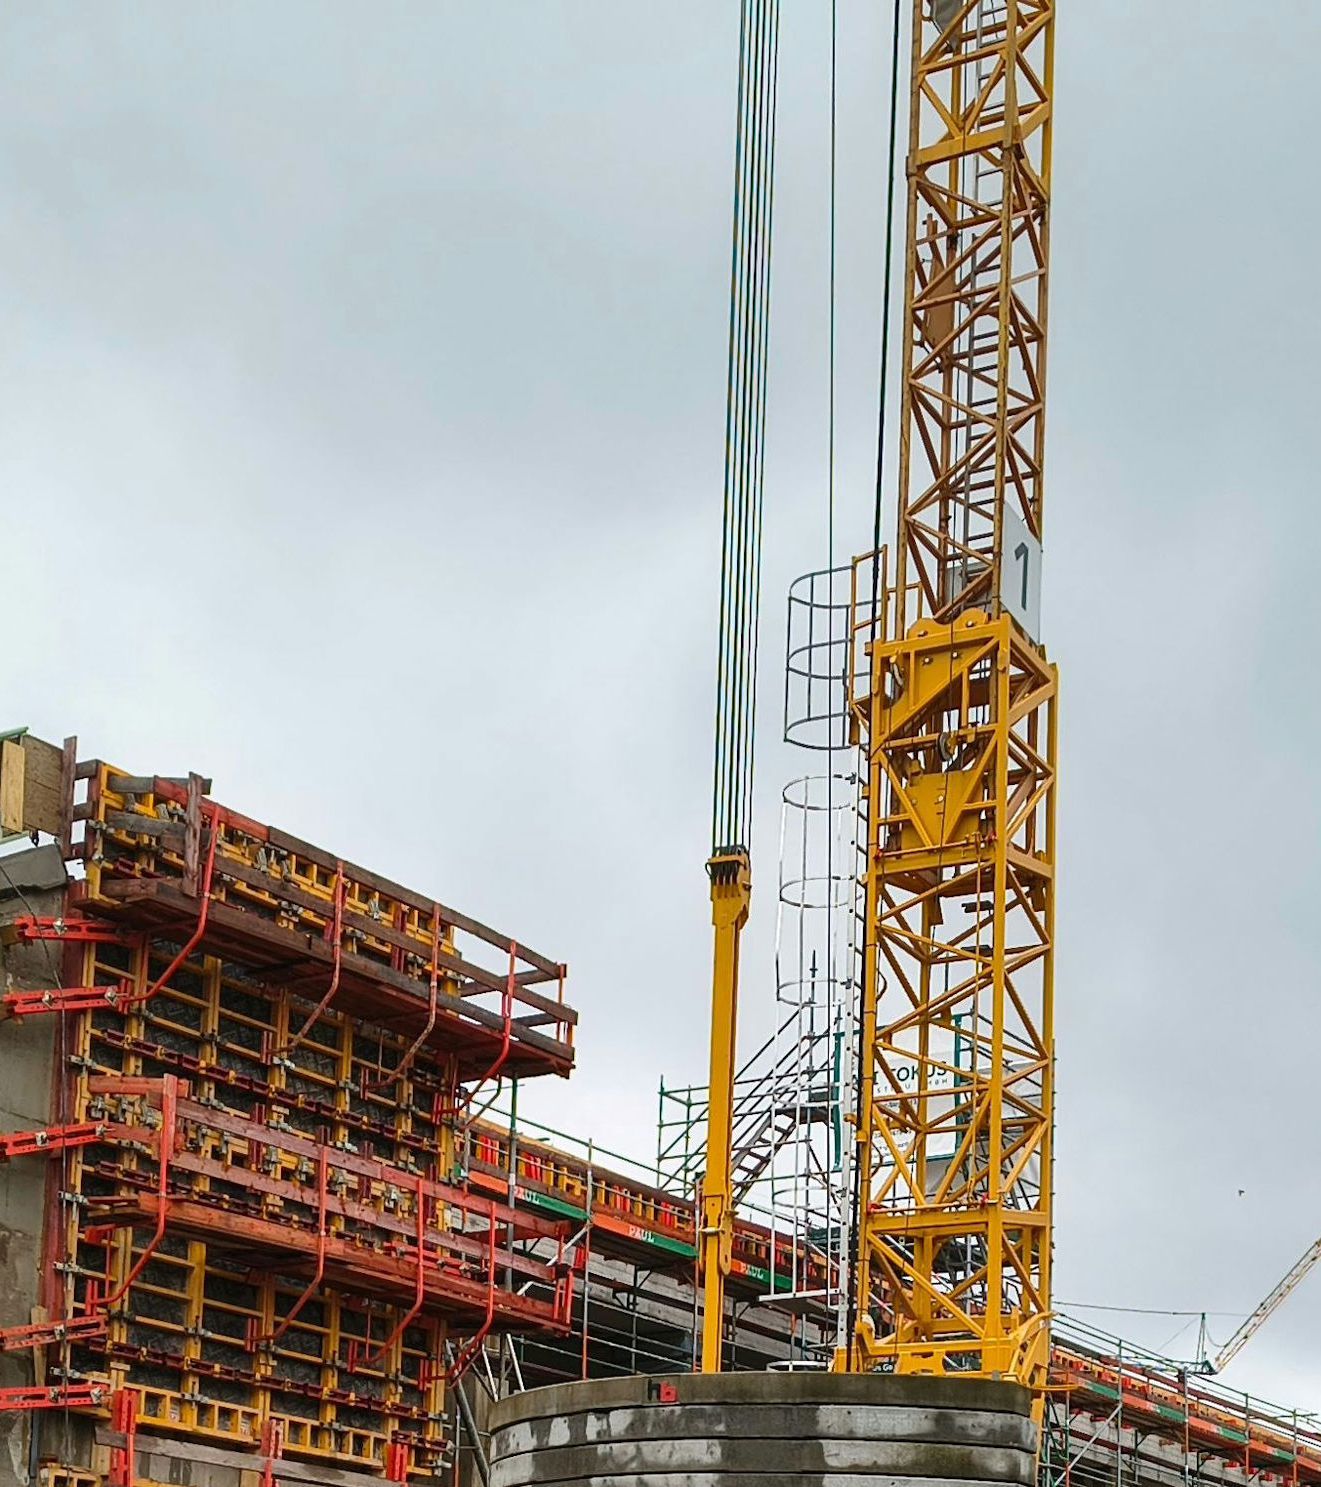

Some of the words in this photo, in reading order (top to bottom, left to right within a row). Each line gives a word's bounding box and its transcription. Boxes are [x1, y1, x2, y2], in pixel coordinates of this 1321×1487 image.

[1014, 542, 1029, 611] 1
[629, 1224, 654, 1243] PAUL
[740, 1261, 764, 1280] PAUL
